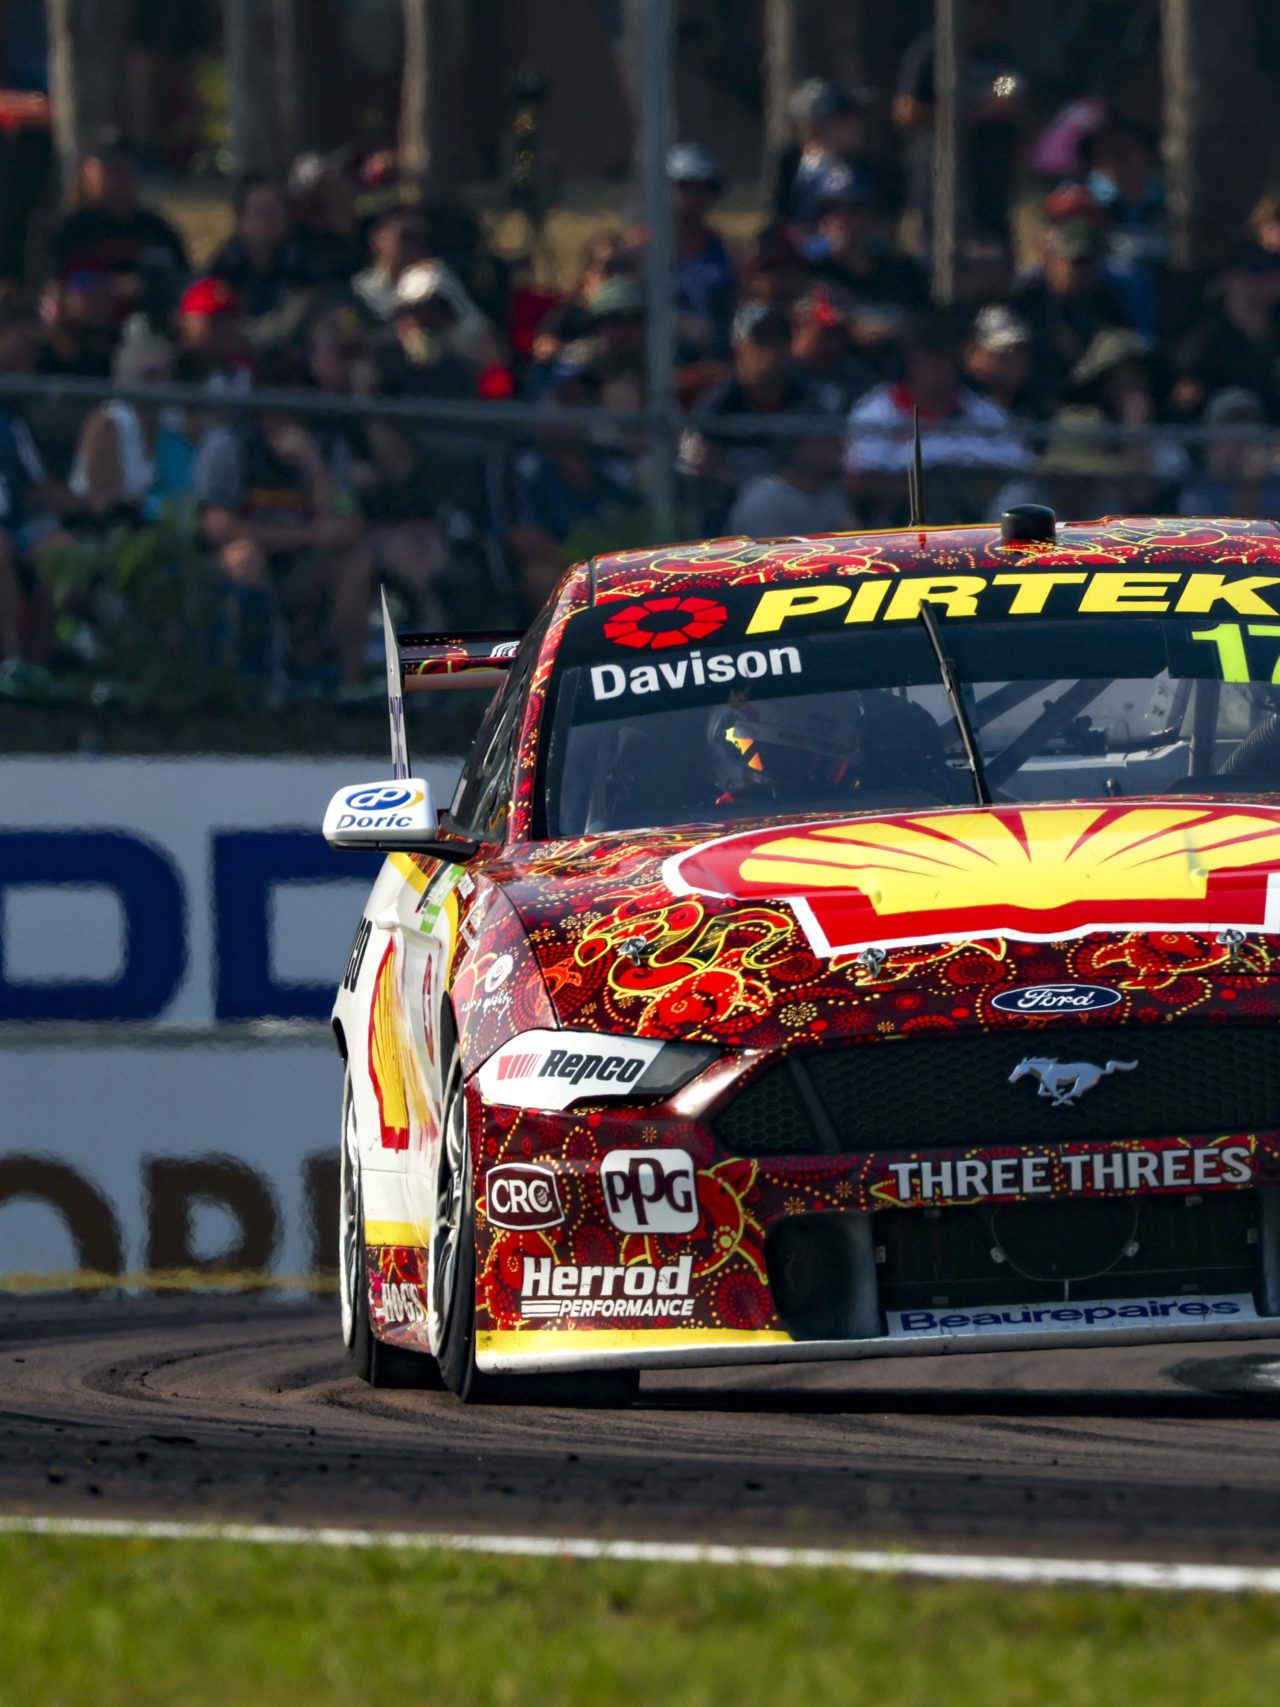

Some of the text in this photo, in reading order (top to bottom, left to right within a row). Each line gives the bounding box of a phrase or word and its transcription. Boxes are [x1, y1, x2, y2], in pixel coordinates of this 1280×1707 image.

[591, 646, 802, 701] Davison
[336, 813, 413, 829] Doric
[1018, 987, 1096, 1008] Ford
[538, 1049, 645, 1085] Repco
[889, 1147, 1252, 1199] THREE THREES
[491, 1179, 553, 1214] CRC
[605, 1157, 694, 1226] PPG
[521, 1255, 694, 1298] Herrod
[558, 1299, 695, 1317] PERFORMANCE
[902, 1299, 1242, 1332] Beaurepaires
